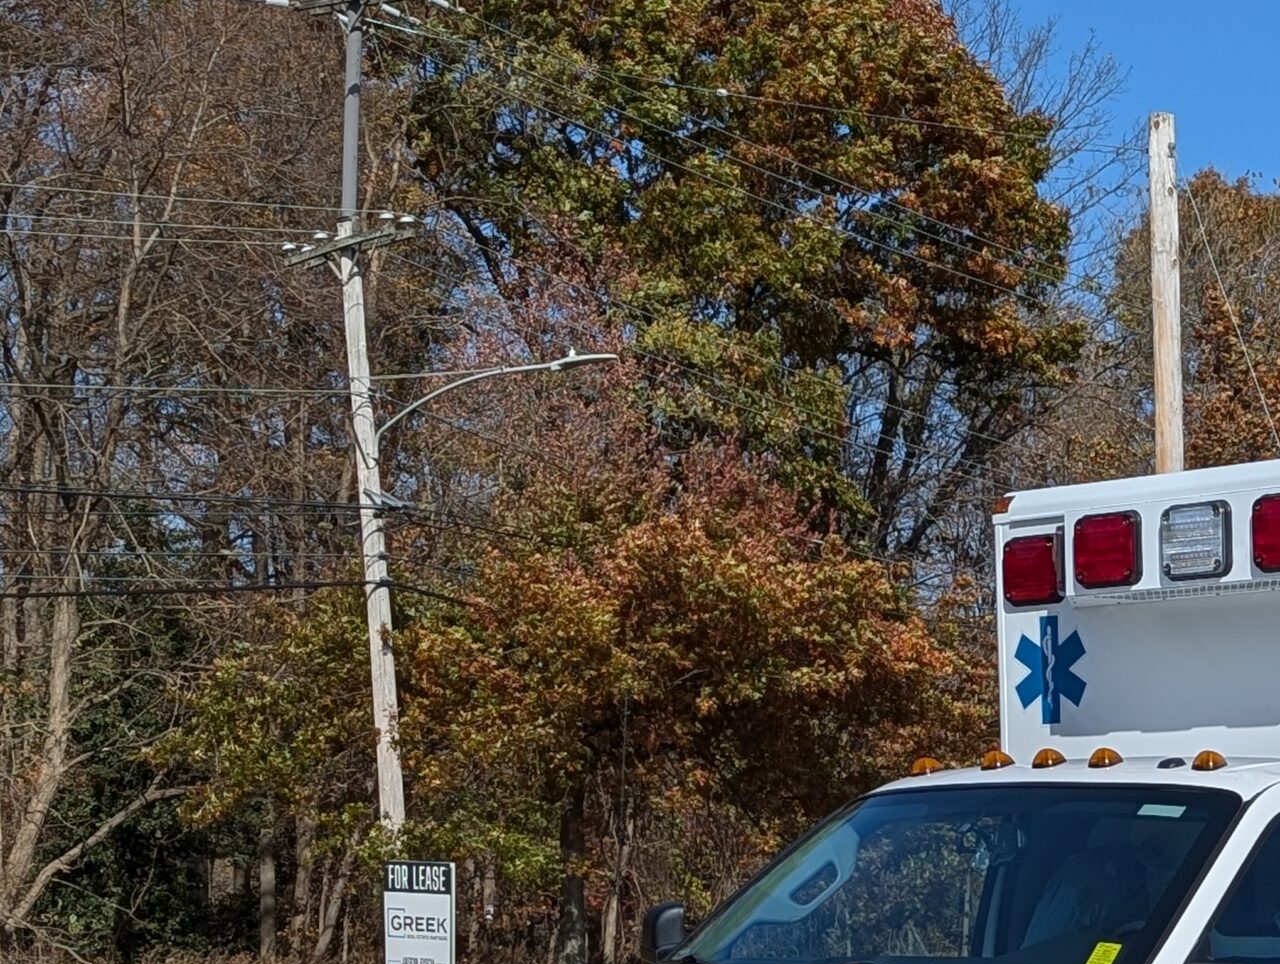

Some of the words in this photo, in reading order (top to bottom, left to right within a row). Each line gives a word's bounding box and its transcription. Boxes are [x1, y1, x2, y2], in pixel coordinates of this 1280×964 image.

[388, 864, 409, 889] FOR
[412, 865, 447, 891] LEASE
[391, 914, 448, 934] GREEK
